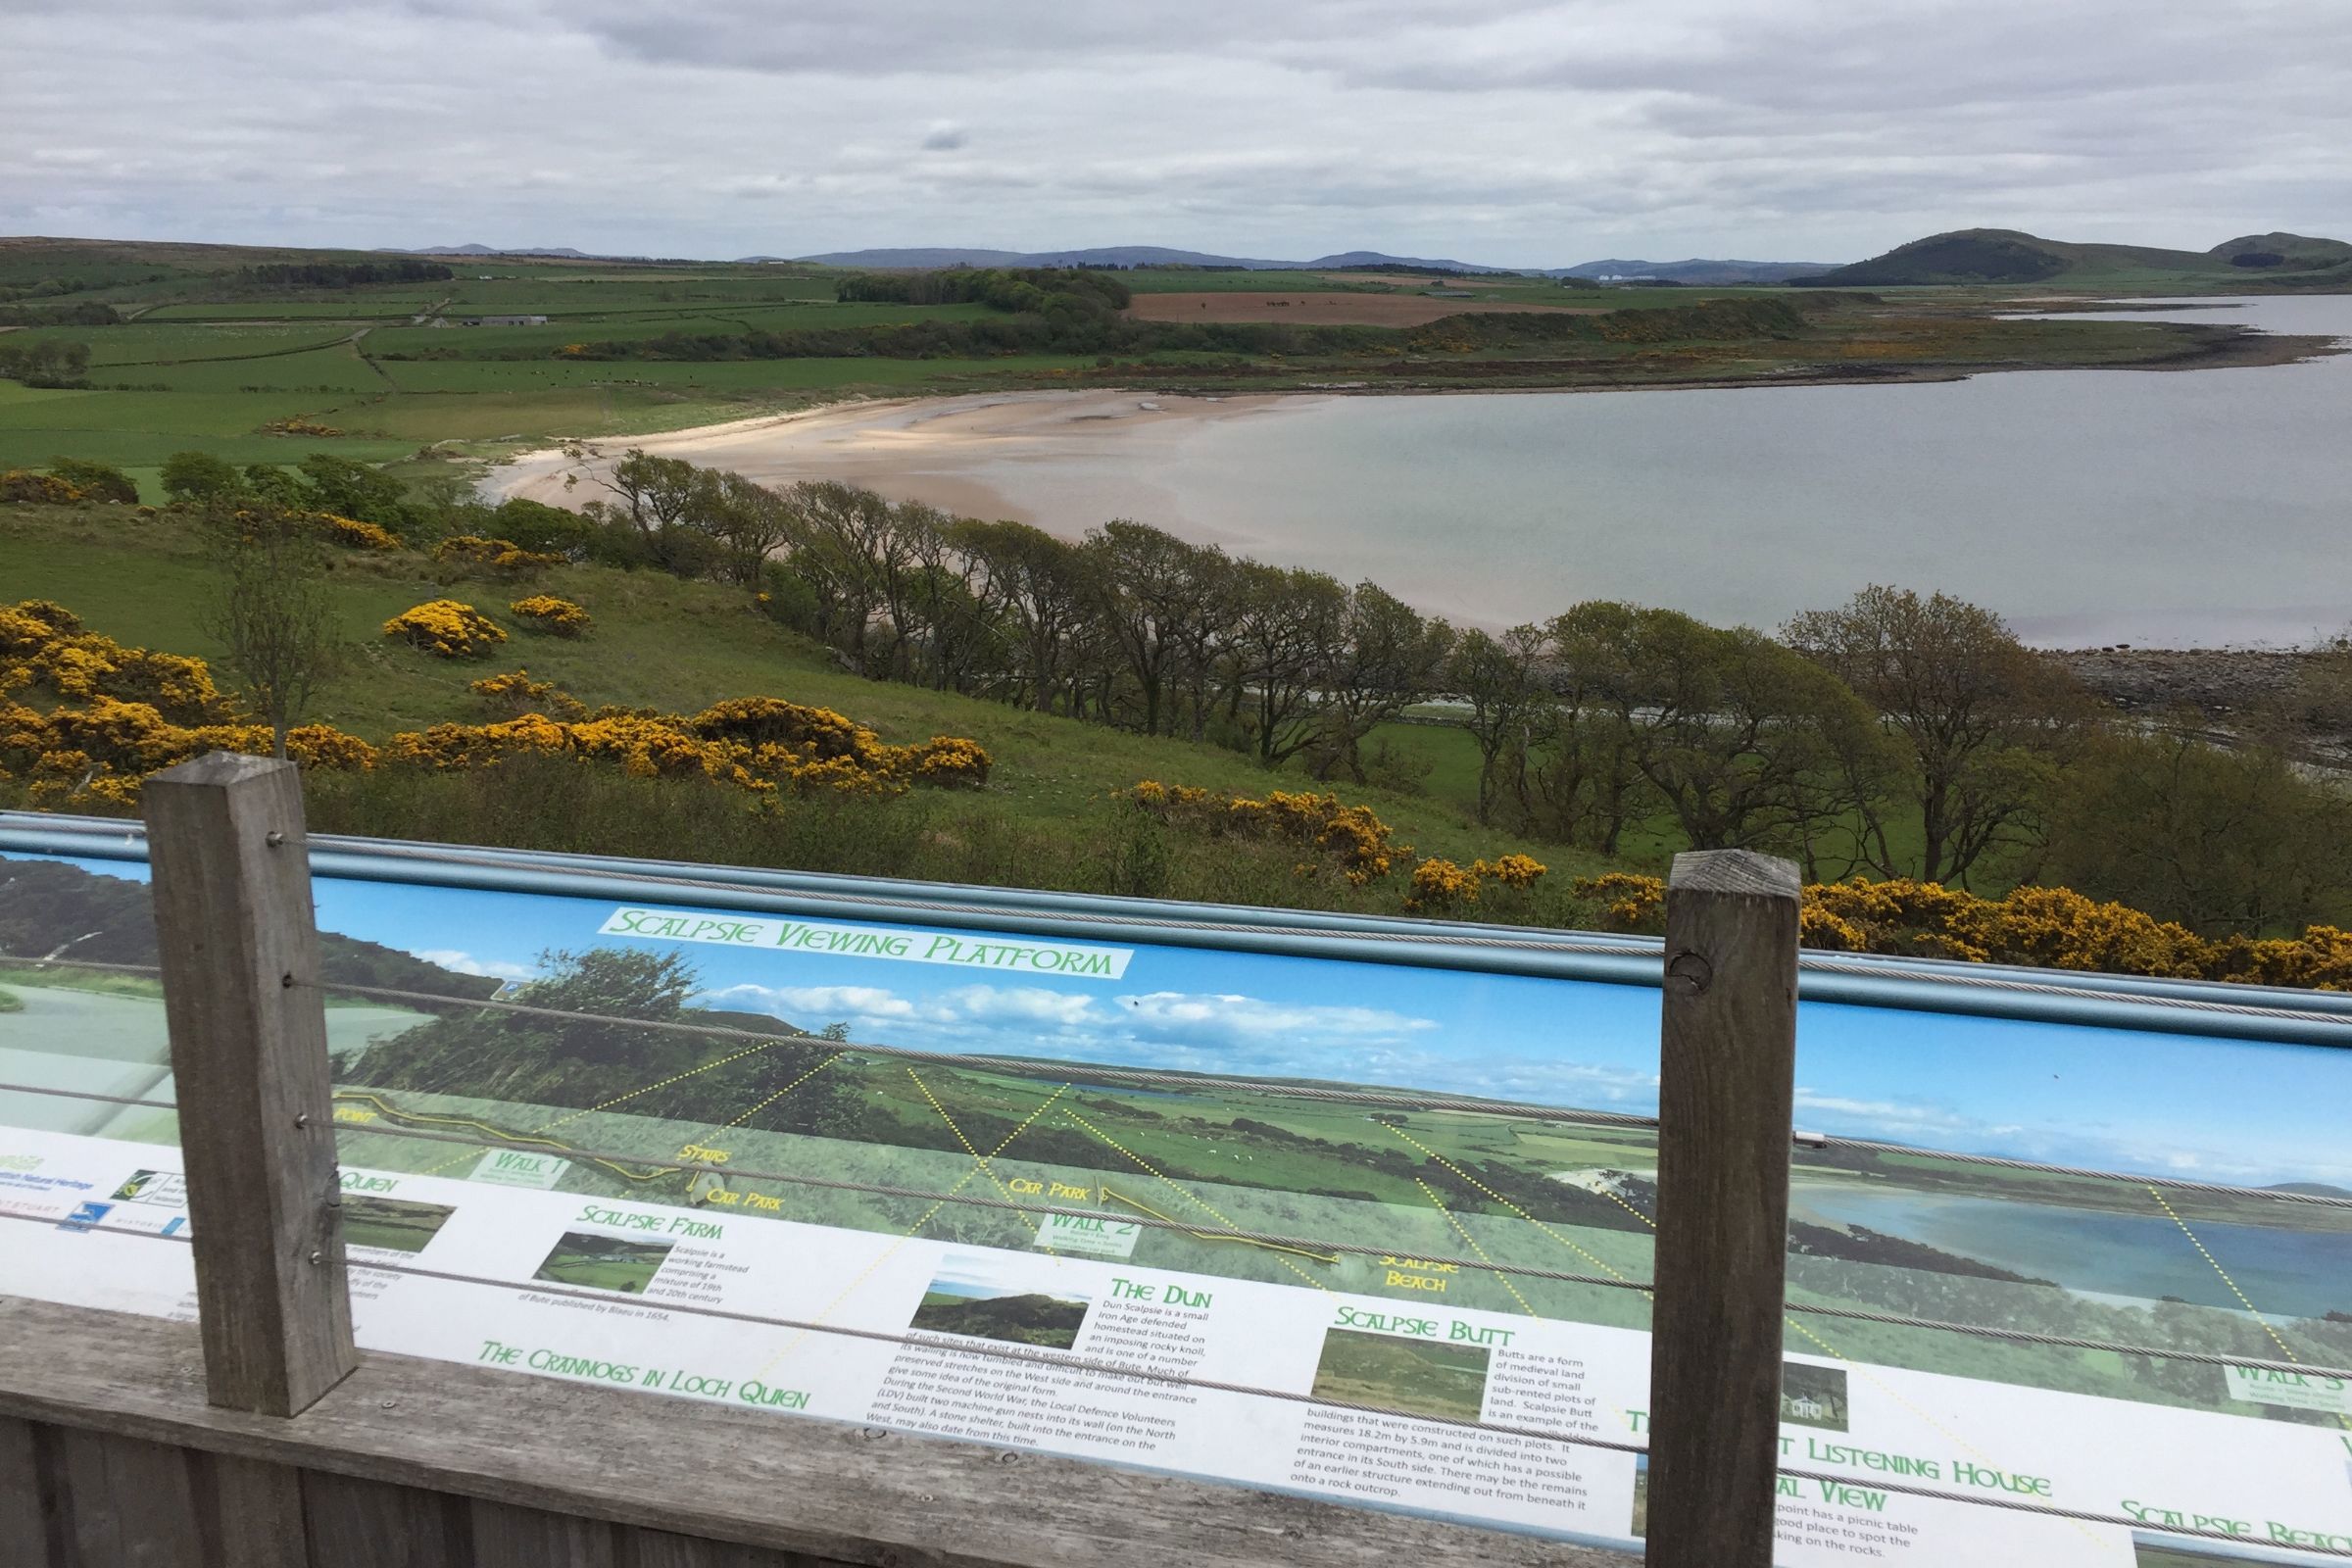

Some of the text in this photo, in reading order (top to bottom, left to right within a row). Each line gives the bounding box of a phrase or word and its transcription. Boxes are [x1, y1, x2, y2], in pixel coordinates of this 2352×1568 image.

[610, 909, 1112, 974] SCALPSIE VIEWING PLATFORM
[333, 1107, 377, 1122] POINT
[495, 1152, 565, 1174] WALK 1
[679, 1145, 732, 1162] STAIRS
[339, 1172, 399, 1193] QUIEN
[1009, 1178, 1091, 1200] CAR PARK
[707, 1188, 785, 1210] CAR PARK
[575, 1204, 723, 1240] SCALPSIE FARM
[1052, 1213, 1135, 1235] WALK 2
[674, 1246, 710, 1257] Scalpsie
[661, 1267, 708, 1280] comprising
[668, 1257, 750, 1273] working farmstead
[1379, 1255, 1459, 1274] SCALPSIE
[654, 1277, 688, 1286] mixture
[702, 1283, 722, 1292] 19th
[1386, 1270, 1446, 1293] BEACH
[666, 1289, 687, 1298] 20th
[688, 1294, 723, 1304] century
[1111, 1278, 1212, 1308] THE DUN
[1102, 1300, 1122, 1309] Dun
[1124, 1303, 1162, 1315] Scalpsie
[1184, 1312, 1209, 1321] small
[1094, 1322, 1149, 1337] homestead
[1151, 1332, 1190, 1342] situated
[1119, 1314, 1139, 1324] Age
[1141, 1316, 1188, 1330] defended
[1334, 1306, 1515, 1347] SCALPSIE BUTT
[1104, 1337, 1149, 1348] imposing
[1151, 1343, 1177, 1352] rocky
[1180, 1346, 1206, 1356] knoll,
[1116, 1349, 1135, 1358] one
[1137, 1351, 1149, 1360] of
[1158, 1354, 1198, 1367] number
[1497, 1349, 1525, 1360] Butts
[1529, 1352, 1545, 1363] are
[1557, 1356, 1584, 1367] form
[478, 1340, 811, 1410] THE CRANNOGS IN LOCH QUIEN
[1495, 1361, 1585, 1380] of medieval land
[1494, 1373, 1581, 1392] division of small
[883, 1377, 1176, 1427] During the Second World War, the Local Defence Volunteers
[1492, 1385, 1596, 1406] sub-rented plots of
[1491, 1396, 1592, 1418] land. Scalpsie Butt
[866, 1411, 1038, 1446] West, may also date from this time.
[1307, 1408, 1571, 1453] buildings that were constructed on such plots. It
[1303, 1422, 1567, 1466] measures 18.2m by 5.9m and is divided into two
[1300, 1434, 1341, 1446] interior
[1343, 1441, 1425, 1460] compartments,
[1429, 1452, 1449, 1463] one
[1468, 1458, 1500, 1470] which
[1503, 1462, 1523, 1473] has
[1536, 1468, 1583, 1483] possible
[1808, 1437, 1941, 1481] LISTENING
[1952, 1460, 2053, 1497] HOUSE
[1291, 1473, 1316, 1484] onto
[1328, 1478, 1351, 1490] rock
[1354, 1483, 1400, 1497] outcrop.
[1819, 1480, 1887, 1512] VIEW
[1778, 1503, 1809, 1518] point
[1812, 1508, 1835, 1521] has
[1847, 1514, 1882, 1530] picnic
[1886, 1519, 1919, 1535] table
[1806, 1523, 1840, 1537] place
[1842, 1528, 1856, 1539] to
[1859, 1531, 1886, 1546] spot
[1889, 1536, 1911, 1548] the
[1805, 1538, 1822, 1547] on
[1825, 1539, 1845, 1551] the
[1848, 1543, 1886, 1558] rocks.
